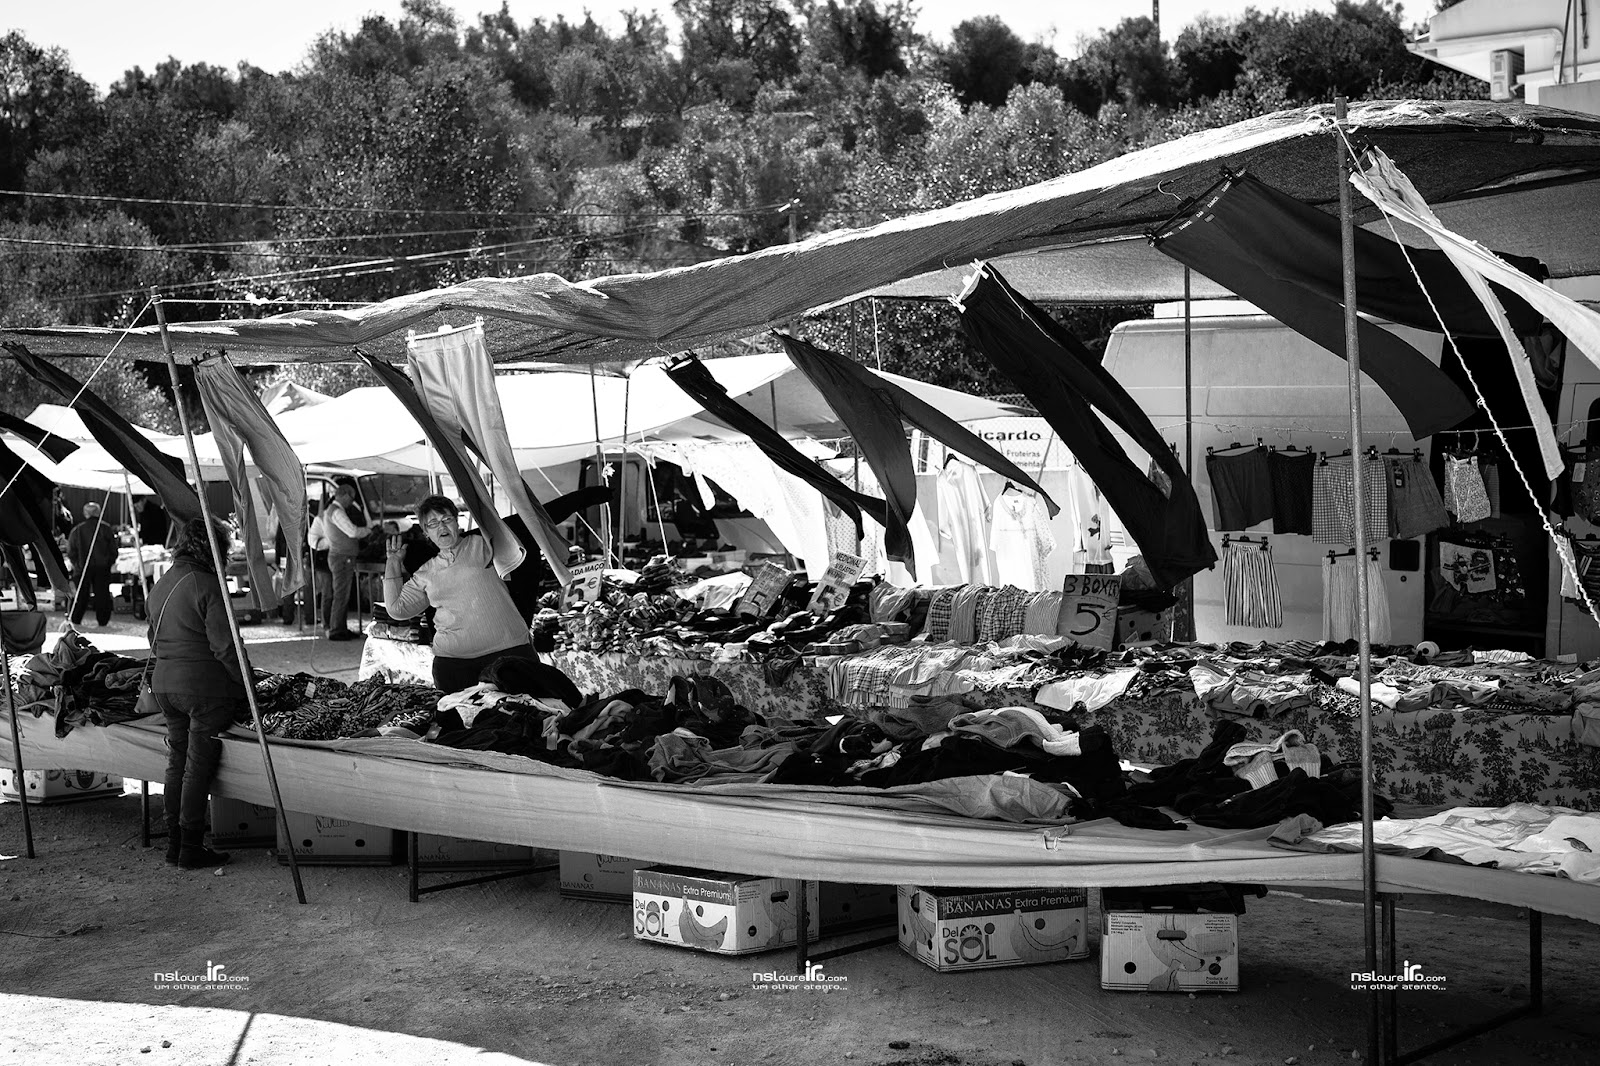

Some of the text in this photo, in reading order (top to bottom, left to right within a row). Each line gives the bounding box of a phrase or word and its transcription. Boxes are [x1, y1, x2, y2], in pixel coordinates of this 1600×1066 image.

[978, 429, 1041, 441] icardo
[1065, 576, 1078, 593] 3
[562, 882, 594, 890] BANANAS
[637, 876, 681, 892] BANANAS
[683, 885, 700, 896] Extra
[700, 888, 730, 900] Premium
[635, 898, 646, 910] Del
[946, 897, 1012, 914] BANANAS
[1015, 898, 1038, 908] Extra
[1040, 894, 1082, 906] Premium
[636, 910, 669, 938] SOL
[942, 926, 959, 938] Del
[944, 934, 997, 964] SOL
